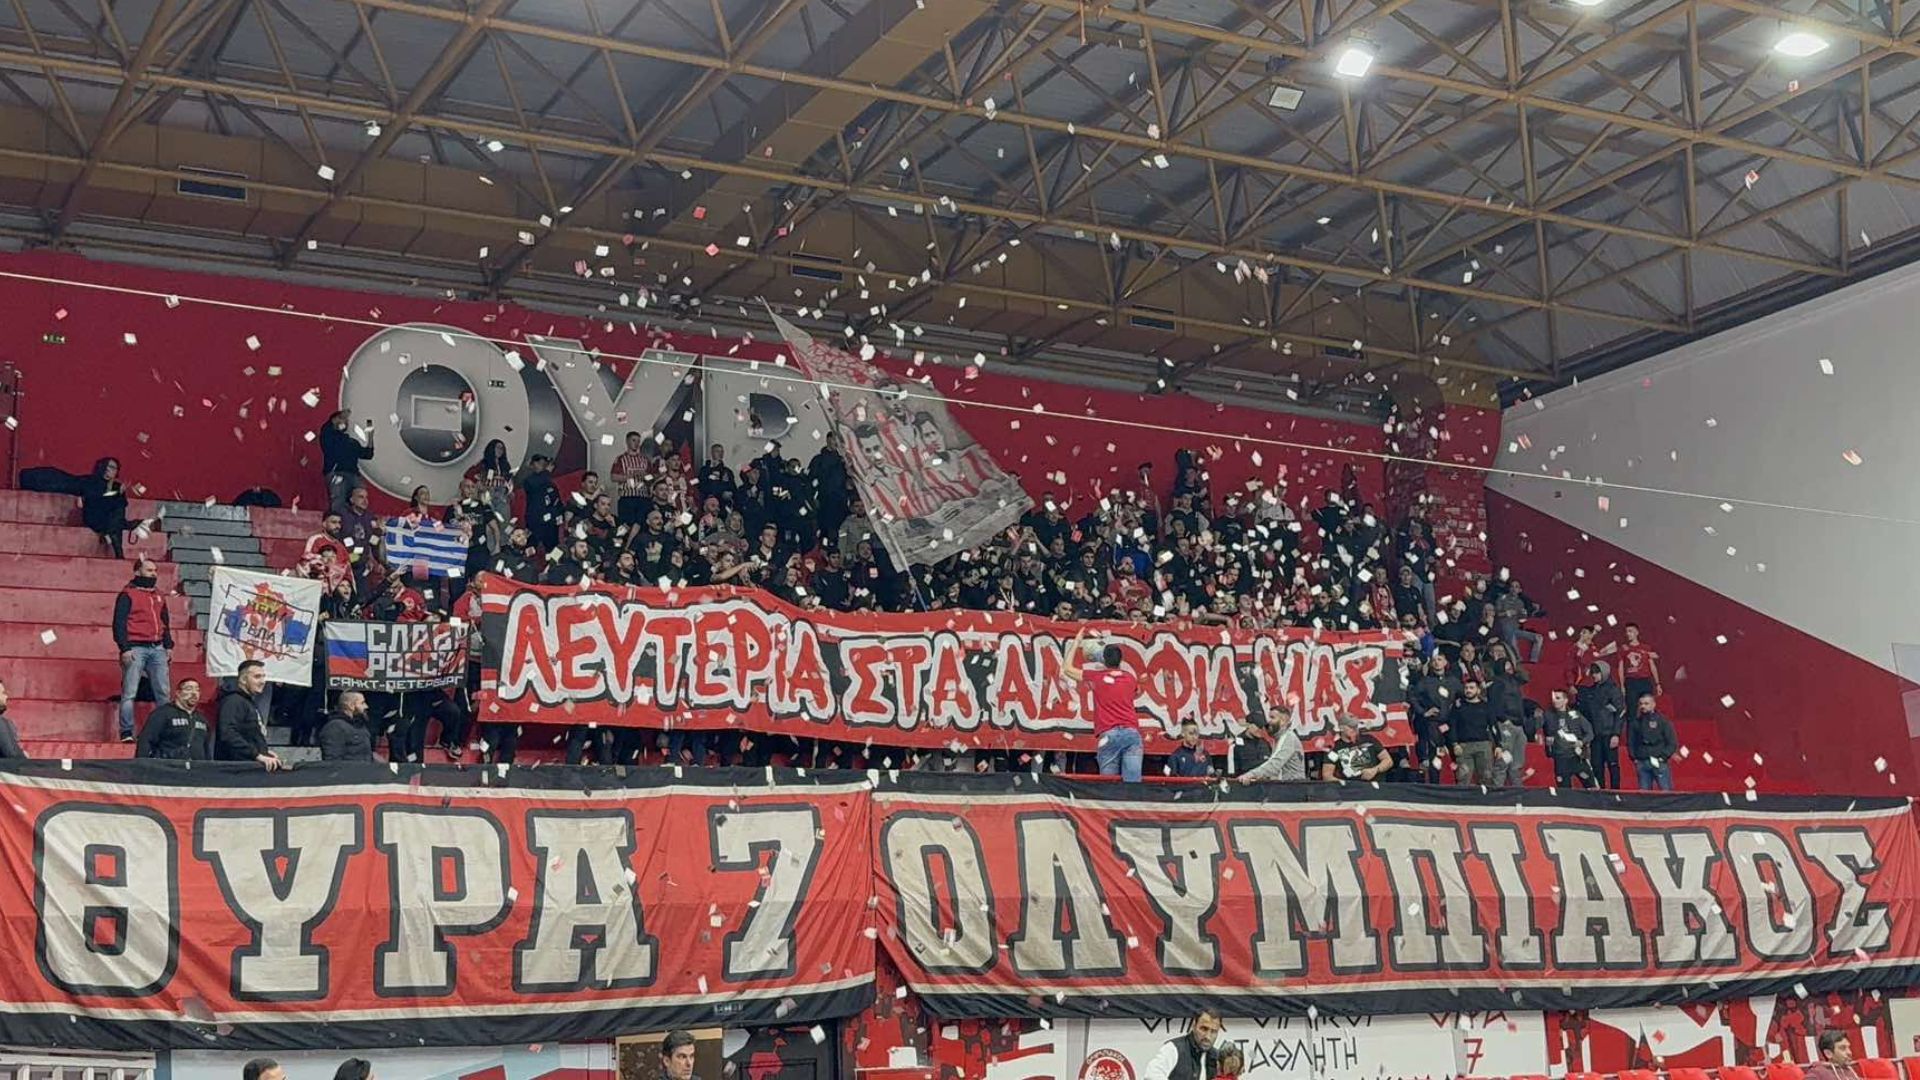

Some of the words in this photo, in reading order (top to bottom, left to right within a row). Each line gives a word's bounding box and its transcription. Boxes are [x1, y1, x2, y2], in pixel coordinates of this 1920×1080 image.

[499, 592, 837, 722] ΛΕΥΤΕΡΙΑ
[840, 631, 980, 730] ΣΤΑ
[36, 803, 657, 997] ΘΥΡΑ
[709, 805, 821, 979] 7
[882, 811, 1894, 976] ΟΛΥΜΠΙΑΚΟΣ
[1463, 1038, 1484, 1074] 7
